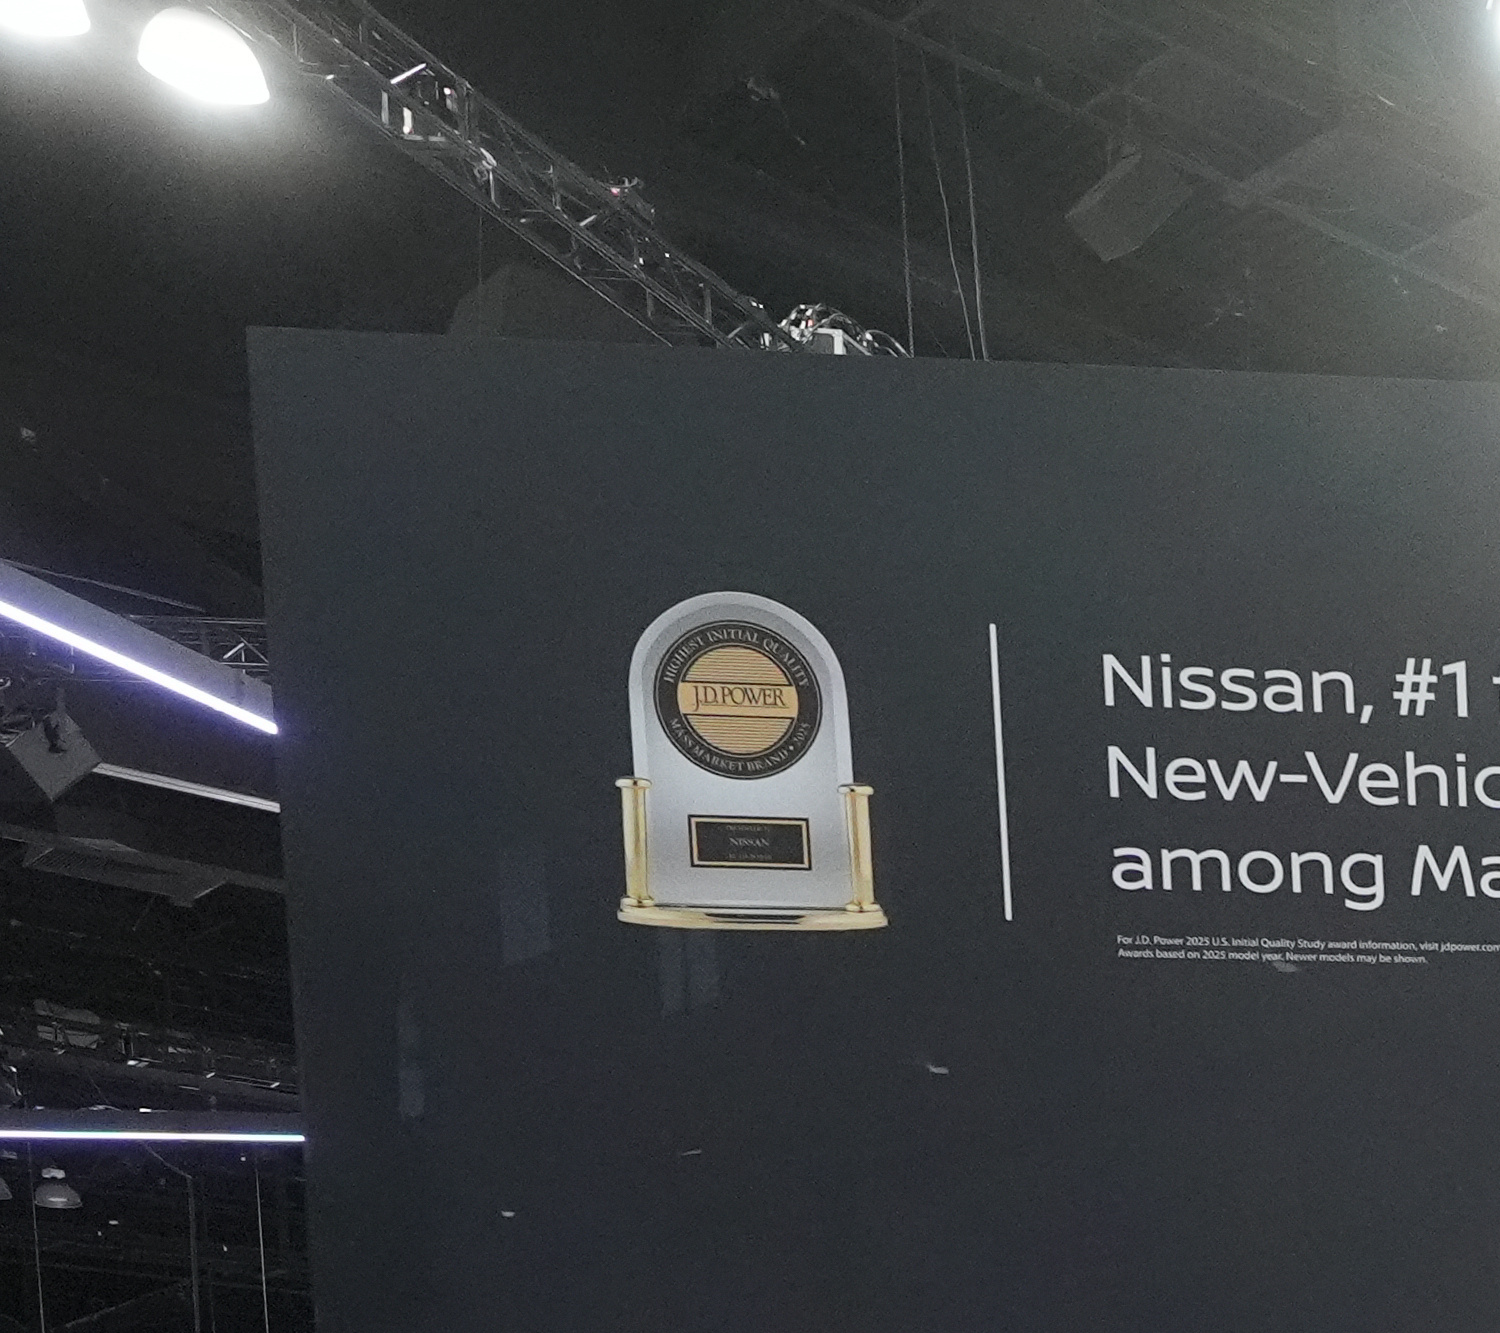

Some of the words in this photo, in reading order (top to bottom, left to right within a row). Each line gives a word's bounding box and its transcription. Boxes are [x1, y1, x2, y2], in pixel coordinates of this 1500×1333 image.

[663, 636, 704, 684] HIGHEST
[707, 628, 759, 643] INITIAL
[763, 638, 810, 687] QUALITY
[693, 685, 718, 712] J.D.
[720, 686, 786, 707] POWER
[1102, 653, 1374, 724] Nissan,
[1393, 658, 1469, 718] #1
[670, 718, 694, 749] MASS
[694, 745, 745, 771] MARKET
[746, 749, 790, 772] BRAND
[1111, 845, 1385, 911] among
[1117, 935, 1133, 945] For
[1153, 936, 1183, 946] Power
[1186, 936, 1210, 946] 2025
[1212, 937, 1230, 947] U.S.
[1232, 937, 1259, 947] Initial
[1261, 938, 1296, 950] Quality
[1298, 938, 1325, 950] Study
[1327, 940, 1357, 950] award
[1359, 940, 1417, 952] information,
[1419, 941, 1439, 951] visit
[1118, 948, 1154, 959] Awards
[1156, 949, 1185, 959] based
[1187, 951, 1200, 959] on
[1202, 950, 1226, 960] 2025
[1228, 950, 1259, 960] model
[1286, 951, 1317, 961] Newer
[1319, 952, 1355, 962] models
[1356, 954, 1377, 965] may
[1379, 953, 1391, 963] be
[1393, 954, 1428, 964] shown.
